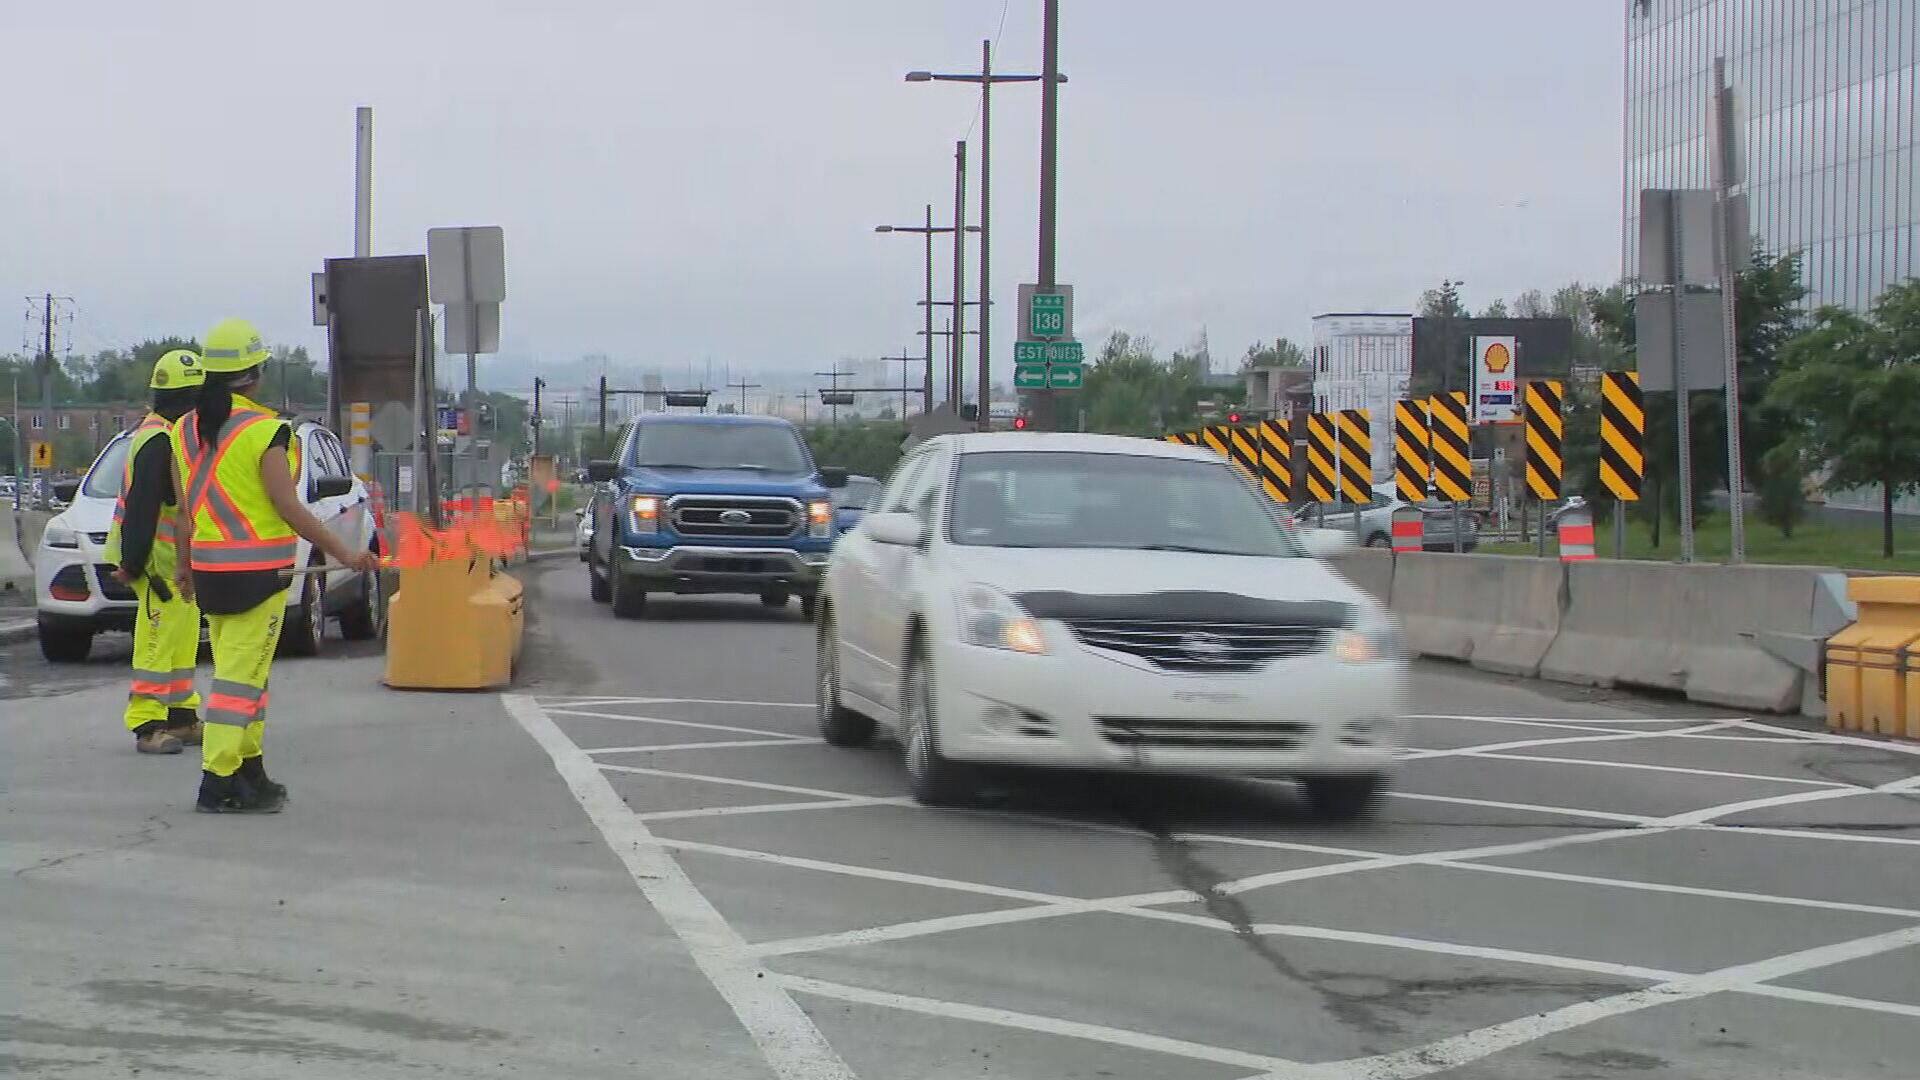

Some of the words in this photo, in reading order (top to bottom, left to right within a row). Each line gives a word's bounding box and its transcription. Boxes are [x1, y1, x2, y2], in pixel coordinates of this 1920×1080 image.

[1036, 313, 1061, 329] 138
[1018, 346, 1043, 359] EST
[1051, 345, 1081, 360] OUEST
